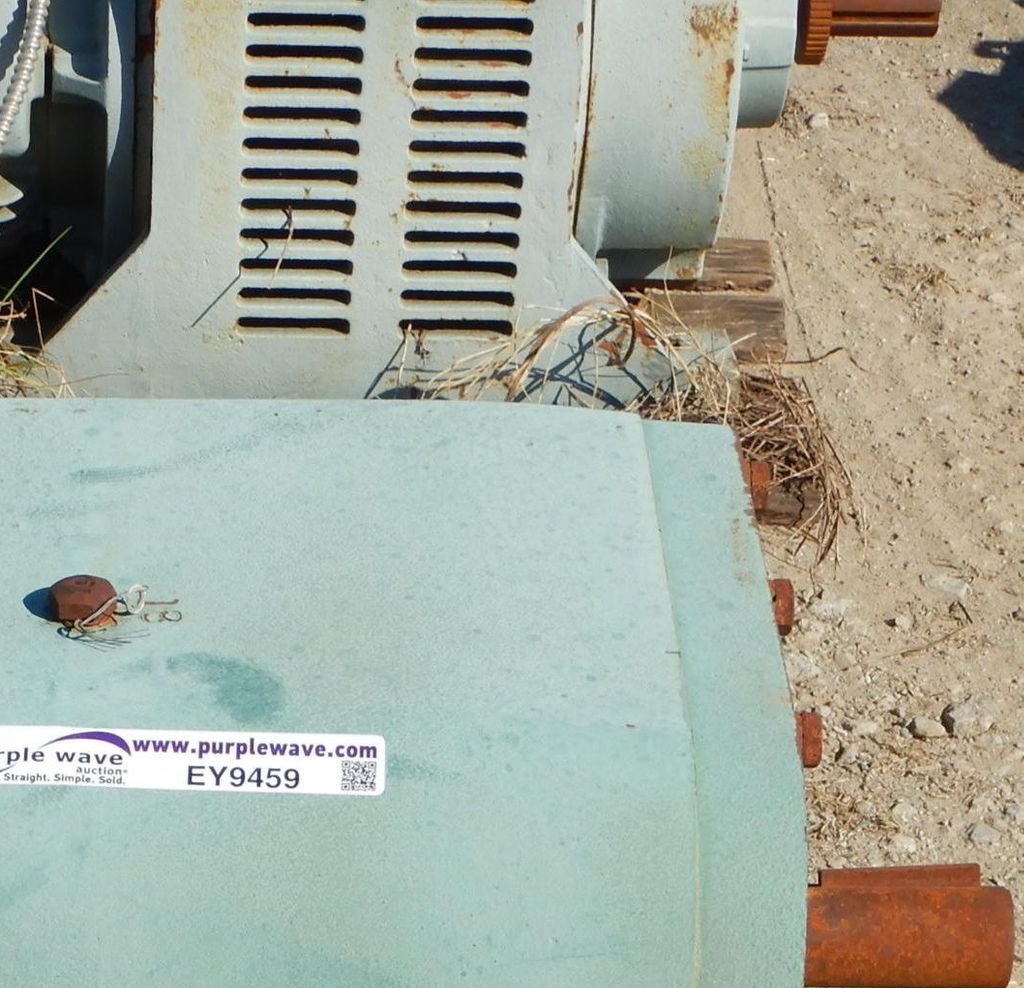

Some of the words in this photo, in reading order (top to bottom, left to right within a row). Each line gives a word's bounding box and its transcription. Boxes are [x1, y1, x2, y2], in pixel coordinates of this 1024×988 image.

[133, 738, 377, 759] www.purplewave.com
[56, 751, 124, 765] wave
[3, 773, 50, 783] Straight.
[54, 773, 95, 784] Simple.
[98, 776, 125, 785] Sold.
[187, 765, 300, 789] EY9459
